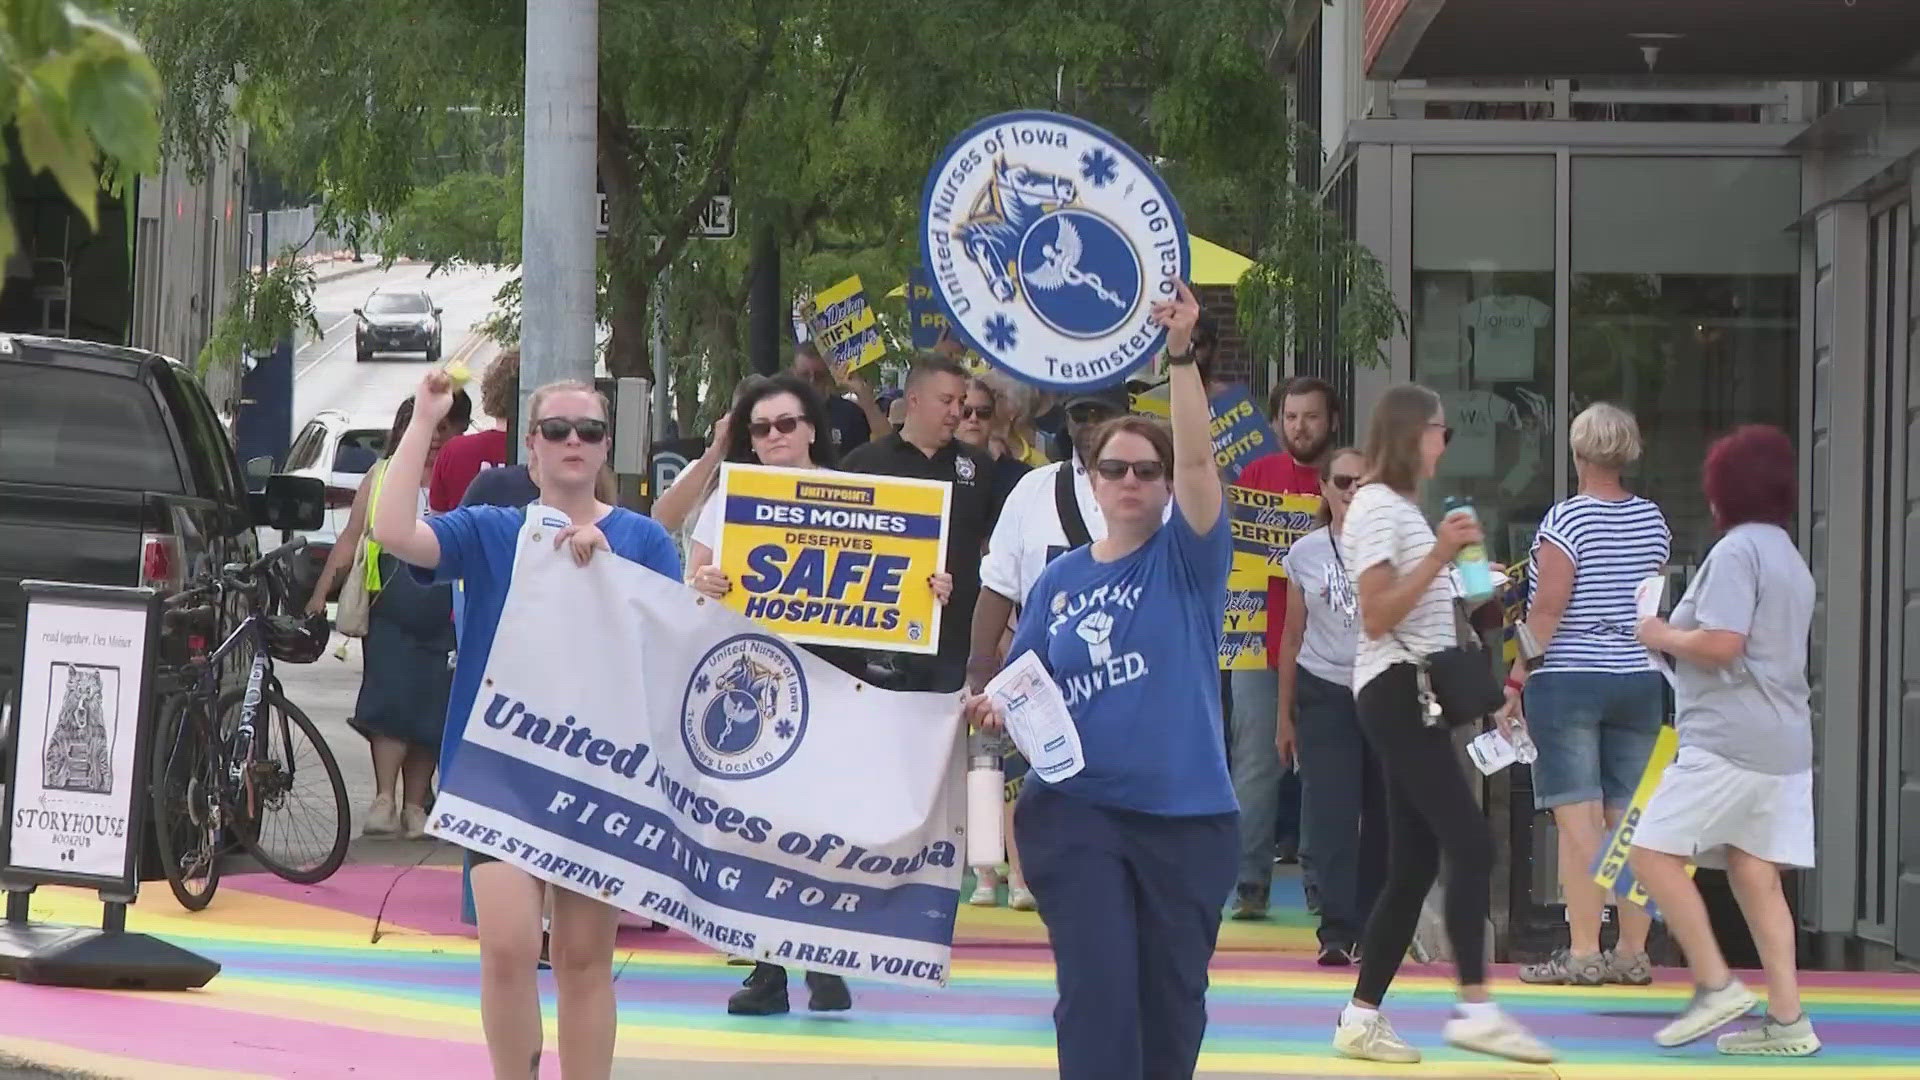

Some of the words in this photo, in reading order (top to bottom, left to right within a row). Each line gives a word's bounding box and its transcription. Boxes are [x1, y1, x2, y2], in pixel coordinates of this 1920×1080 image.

[984, 126, 1005, 155] of
[1011, 126, 1069, 149] Iowa
[933, 149, 982, 223] Nurses
[931, 231, 972, 316] United
[1045, 315, 1160, 379] Teamsters
[1140, 198, 1169, 233] 90
[1209, 400, 1254, 438] ENTS
[1215, 430, 1264, 467] OFITS
[1228, 487, 1284, 508] STOP
[756, 504, 805, 524] DES
[810, 509, 907, 533] MOINES
[785, 533, 873, 550] DESERVES
[741, 543, 911, 604] SAFE
[744, 598, 900, 631] HOSPITALS
[708, 641, 747, 668] United
[751, 641, 785, 667] Nurses
[783, 666, 796, 680] of
[717, 759, 754, 773] Local
[755, 750, 774, 767] 90
[483, 693, 649, 779] United
[645, 752, 772, 844] Nurses
[778, 831, 845, 863] of
[836, 840, 956, 876] Iowa
[16, 808, 125, 838] STORYHOUSE
[546, 790, 741, 893] FIGHTING
[765, 876, 861, 913] FOR
[438, 813, 502, 846] SAFE
[500, 836, 625, 897] STAFFING
[638, 890, 690, 924] FAIR
[691, 914, 756, 950] WAGES
[776, 939, 794, 959] A
[795, 943, 861, 970] REAL
[869, 953, 944, 982] VOICE
